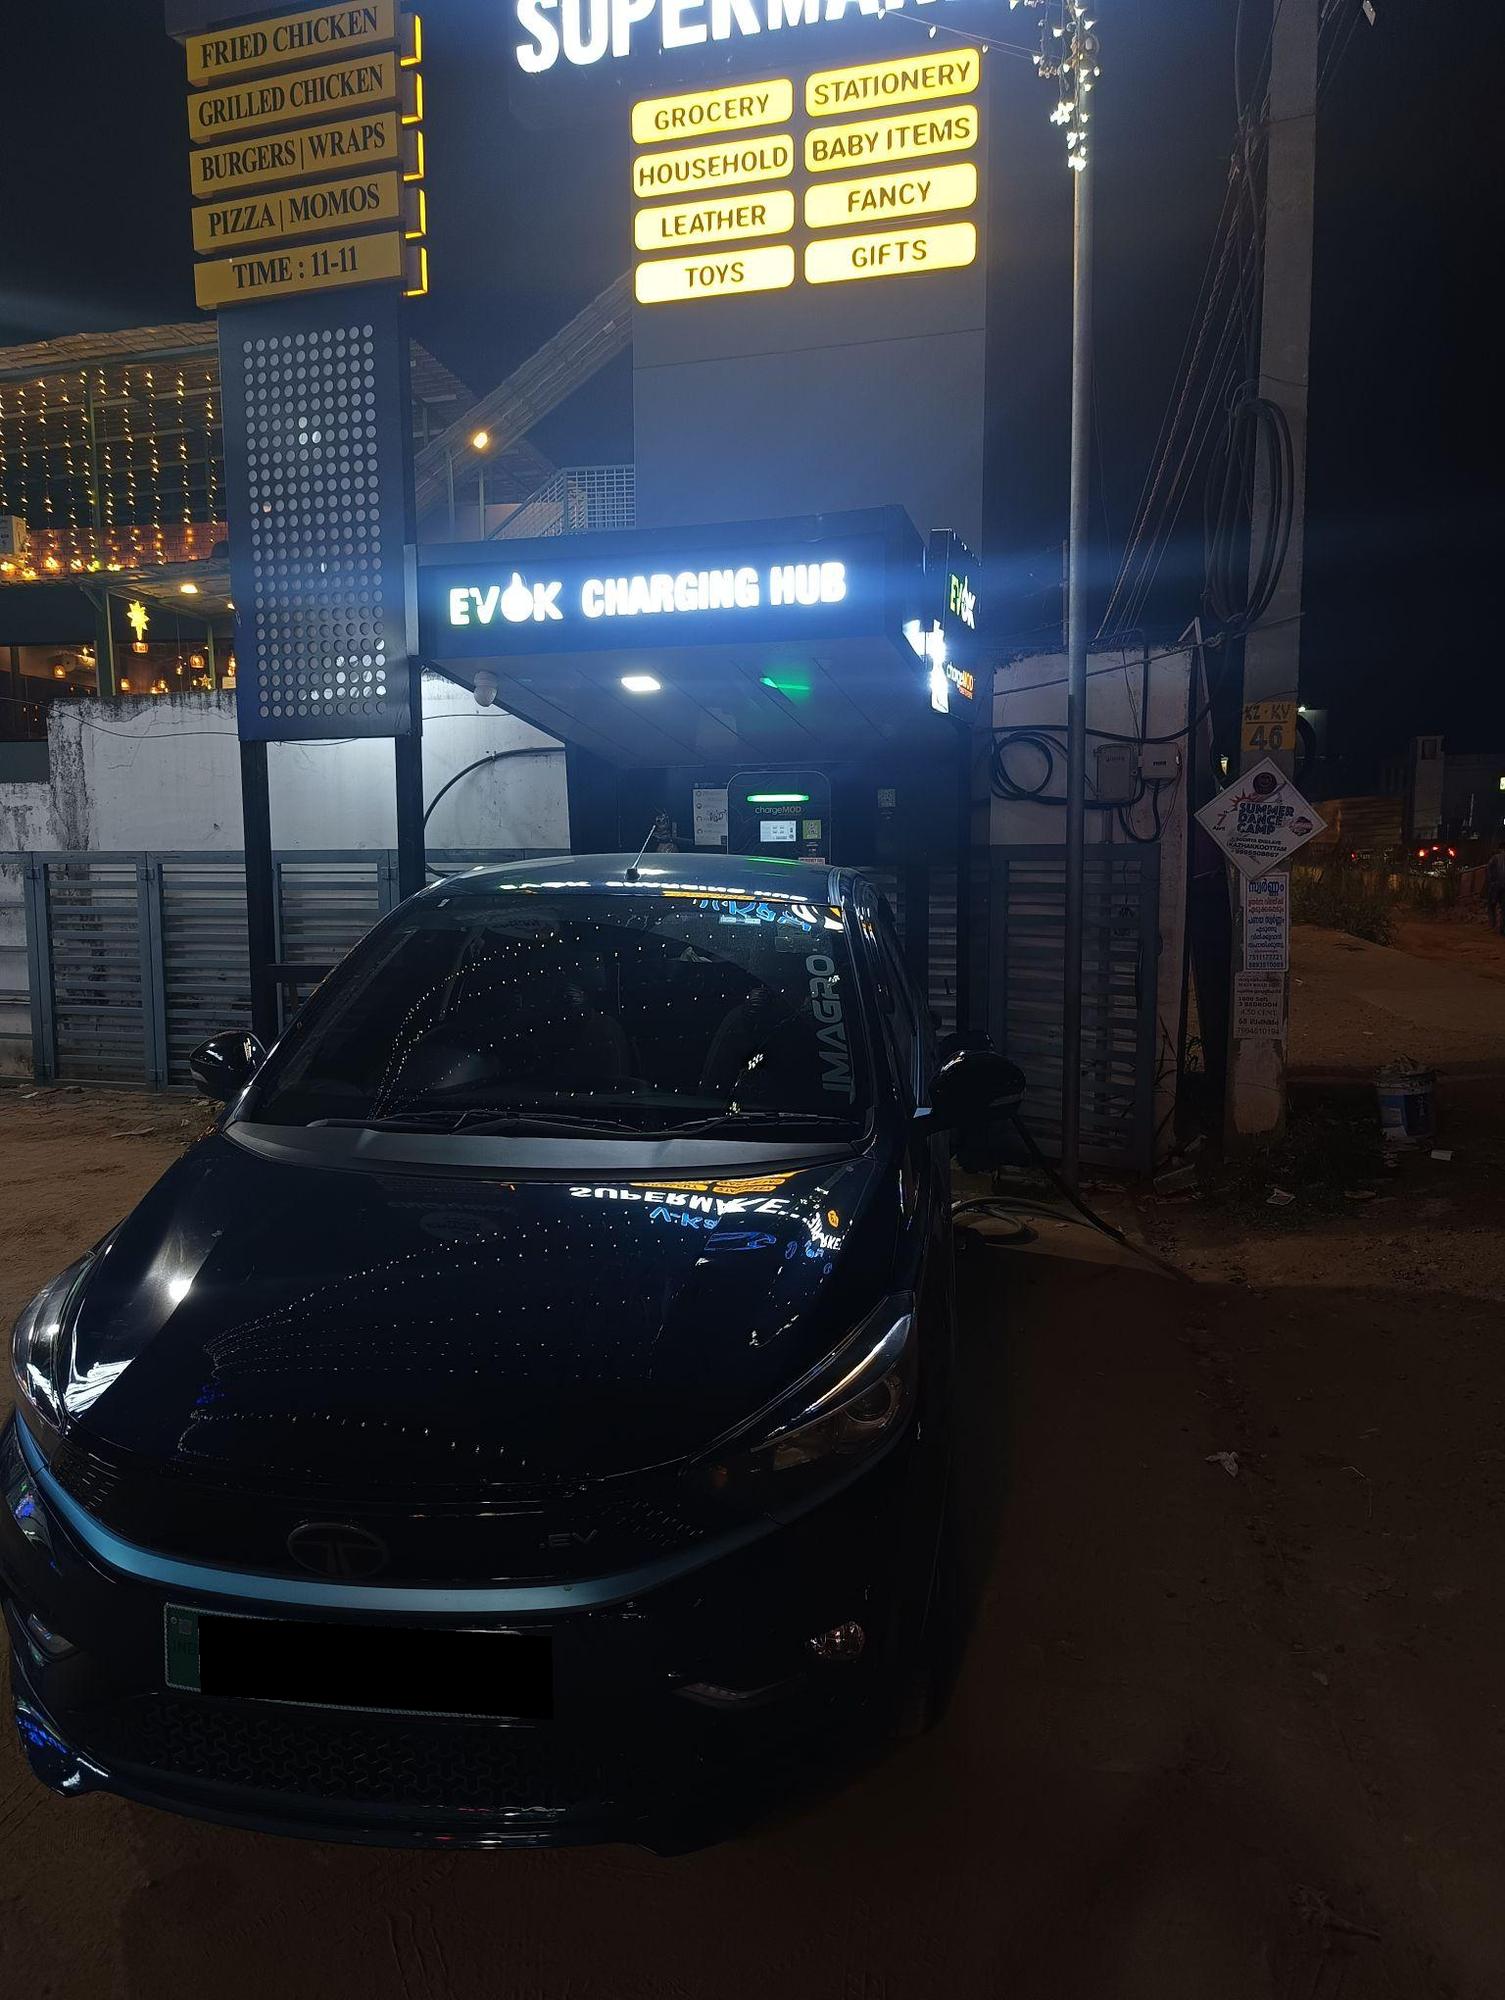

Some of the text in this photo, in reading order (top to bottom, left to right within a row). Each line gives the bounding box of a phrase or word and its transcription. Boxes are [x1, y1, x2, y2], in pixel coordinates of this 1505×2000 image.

[200, 6, 378, 69] FRIED CHICKEN
[199, 64, 383, 127] GRILLED CHICKEN
[814, 61, 970, 105] STATIONERY
[654, 94, 769, 130] GROCERY
[201, 140, 296, 182] BURGERS
[308, 122, 385, 160] WRAPS
[812, 118, 970, 161] BABY ITEMS
[639, 146, 788, 186] HOUSEHOLD
[209, 203, 274, 237] PIZZA
[290, 183, 380, 224] MOMOS
[848, 181, 931, 212] FANCY
[662, 205, 766, 238] LEATHER
[233, 257, 292, 288] TIME
[311, 246, 358, 277] 11-11
[685, 262, 745, 288] TOYS
[852, 240, 927, 269] GIFTS
[582, 568, 759, 617] CHARGING
[770, 562, 846, 605] HUB
[1237, 822, 1276, 835] CAMP
[1238, 812, 1283, 826] DANCE
[1239, 802, 1294, 817] SUMMER
[805, 954, 853, 1093] IMAGRO
